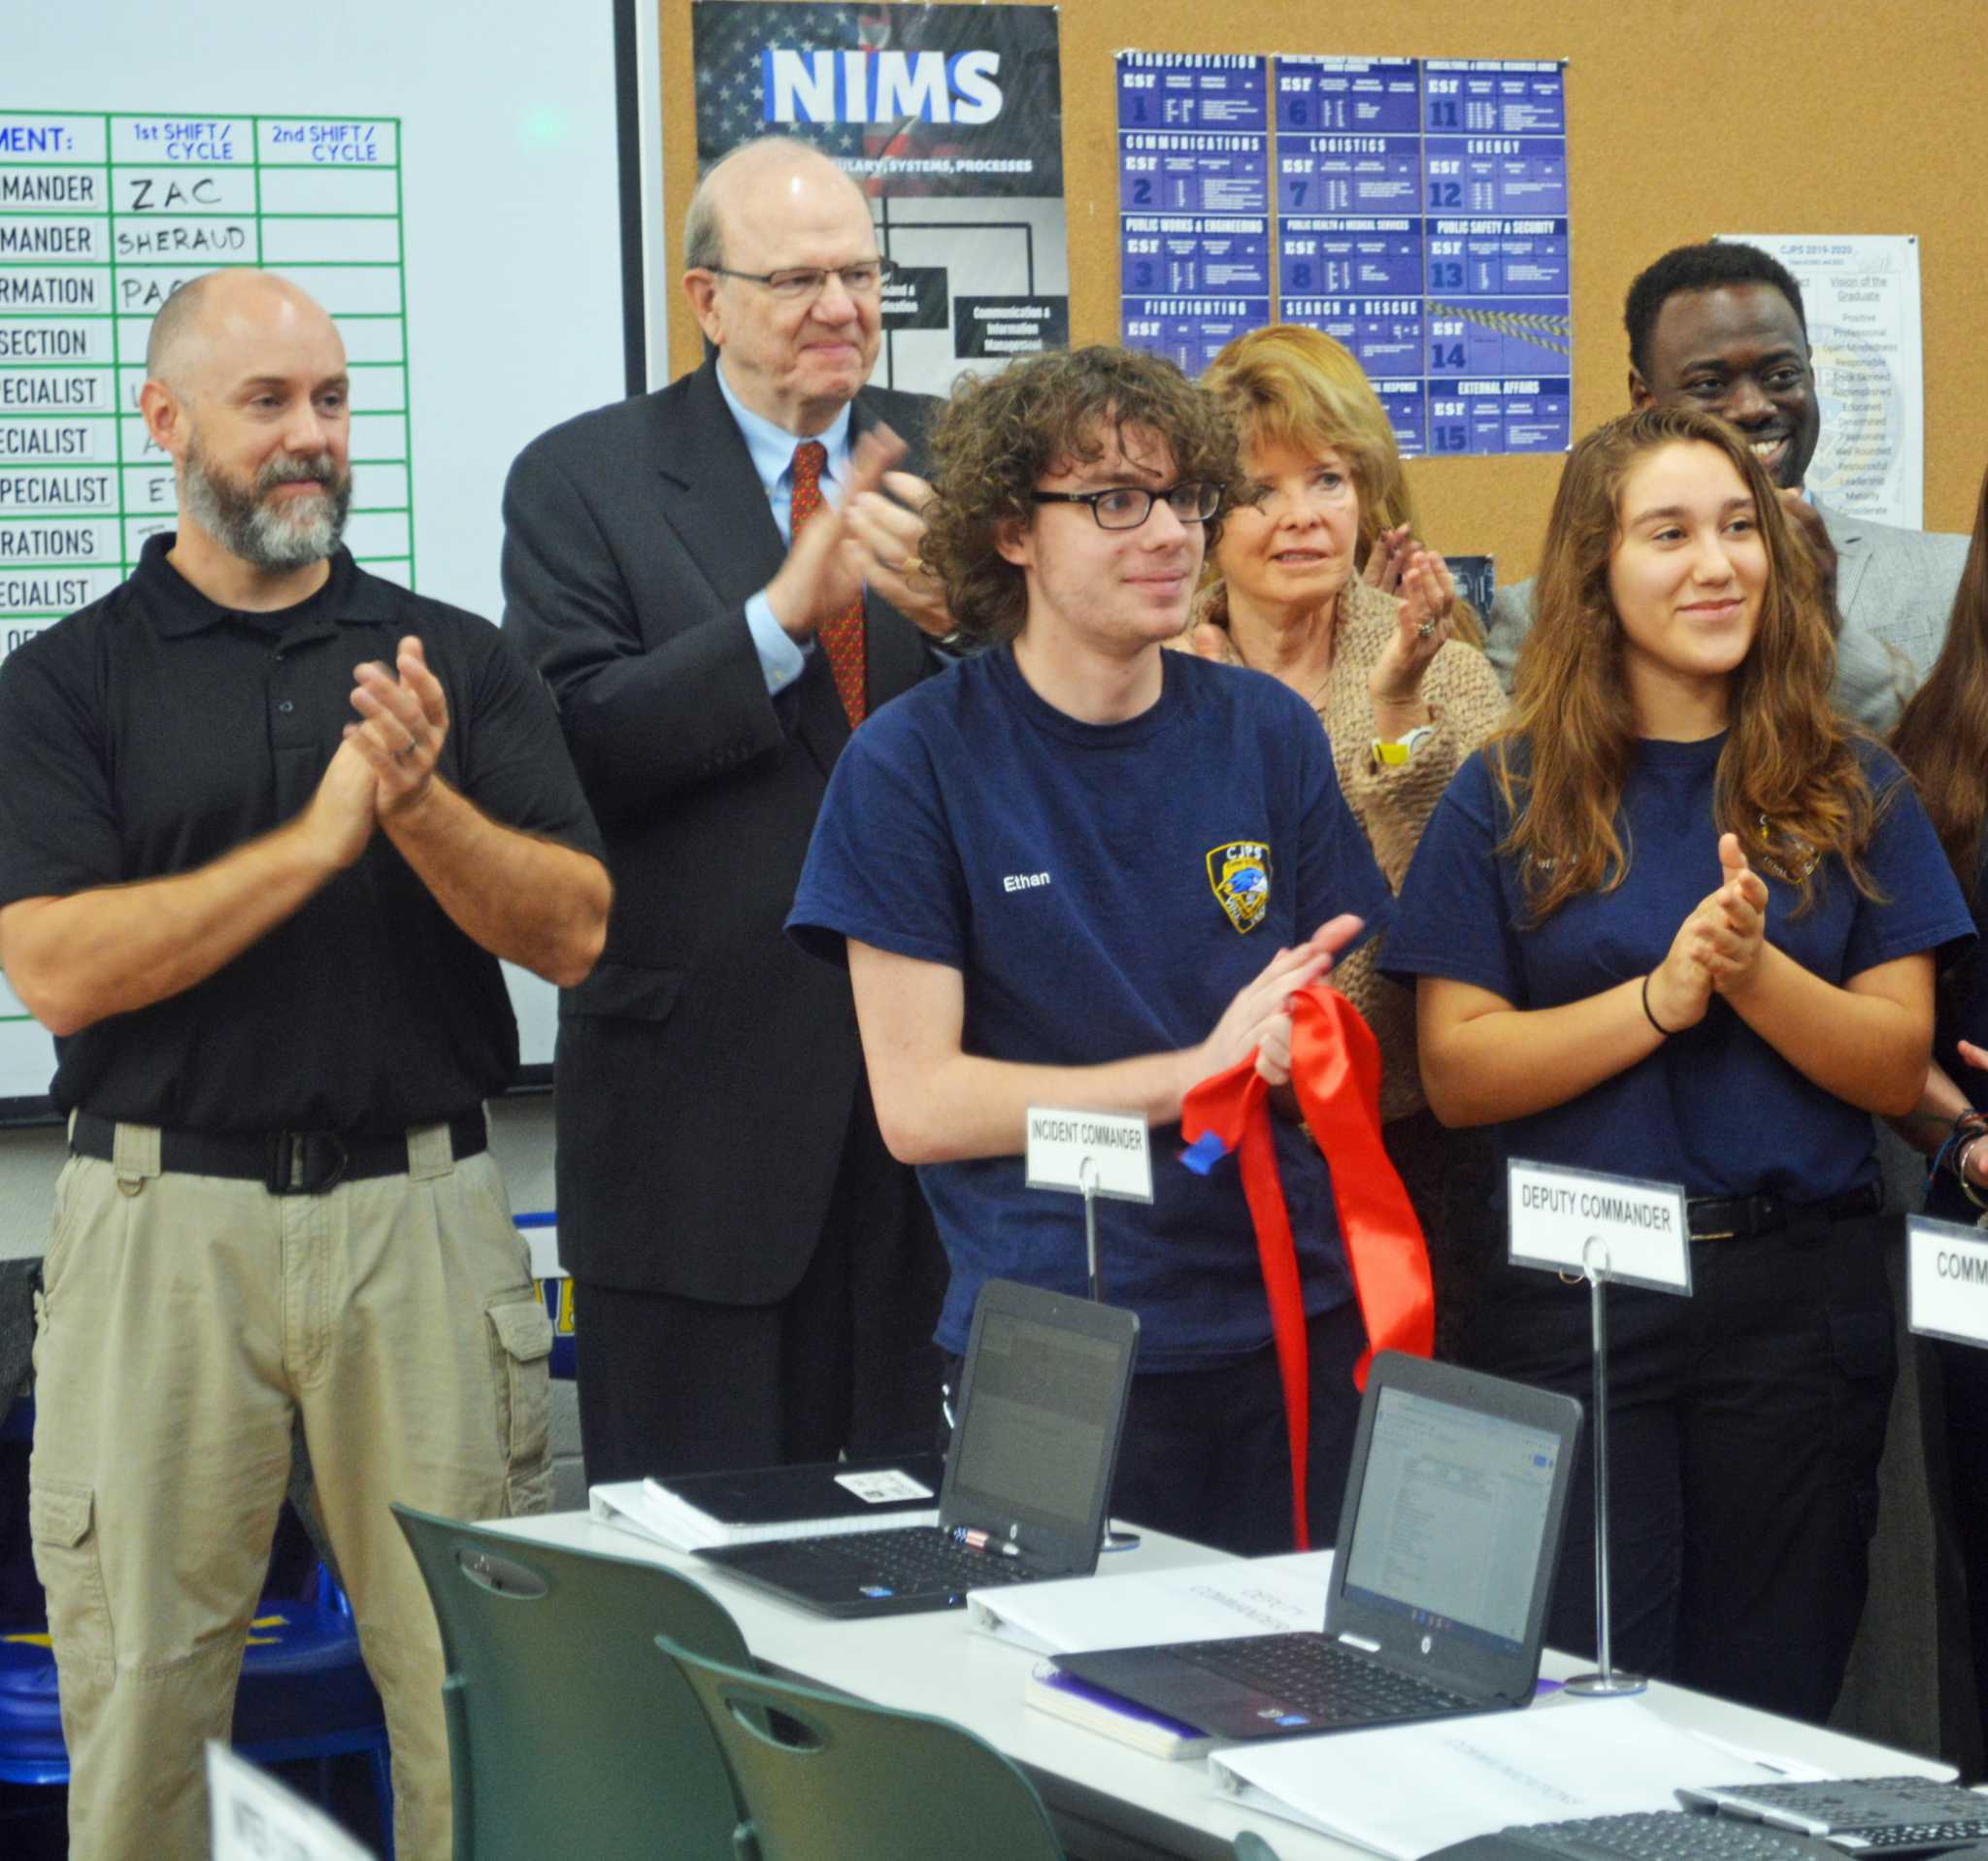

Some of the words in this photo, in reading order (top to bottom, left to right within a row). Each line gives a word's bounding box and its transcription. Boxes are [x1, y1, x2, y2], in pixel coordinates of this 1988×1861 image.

[1126, 53, 1256, 69] TRANSPORTATION
[763, 49, 1004, 124] NIMS
[1123, 74, 1155, 88] ESF
[1280, 77, 1312, 91] ESF
[1428, 80, 1459, 93] ESF
[1134, 96, 1146, 122] 1
[1290, 100, 1308, 125] 6
[1431, 101, 1458, 126] 11
[134, 123, 158, 141] 1st
[163, 123, 231, 141] SHIFT/
[272, 125, 305, 144] 2nd
[310, 125, 375, 144] SHIFT/
[166, 143, 233, 160] CYCLE
[1126, 135, 1259, 150] COMMUNICATIONS
[1310, 138, 1386, 152] LOGISTICS
[1468, 140, 1520, 153] ENERGY
[312, 145, 378, 162] CYCLE
[839, 159, 887, 173] ULARY,
[956, 158, 1032, 172] PROCESSES
[1125, 156, 1157, 171] ESF
[1282, 159, 1313, 173] ESF
[1430, 160, 1460, 174] ESF
[2, 176, 94, 202] MANDER
[130, 178, 221, 212] ZAC
[1133, 179, 1151, 205] 2
[1290, 181, 1308, 207] 7
[1429, 183, 1462, 208] 12
[0, 227, 91, 252] MANDER
[1127, 239, 1159, 253] ESF
[1284, 241, 1316, 254] ESF
[1432, 241, 1462, 255] ESF
[1135, 261, 1153, 287] 3
[1293, 263, 1310, 288] 8
[1432, 262, 1463, 288] 13
[1144, 301, 1246, 316] FIREFIGHTING
[1286, 301, 1341, 316] SEARCH
[1365, 301, 1417, 316] RESCUE
[1128, 322, 1160, 336] ESF
[1433, 322, 1464, 336] ESF
[0, 329, 86, 355] SECTION
[1432, 344, 1466, 369] 14
[3, 378, 96, 404] ECIALIST
[1435, 403, 1466, 416] ESF
[1435, 425, 1467, 451] 15
[1, 529, 94, 555] RATIONS
[1226, 845, 1262, 860] CJPS
[1004, 872, 1051, 892] Ethan
[1033, 1119, 1078, 1143] INCIDENT
[1081, 1123, 1143, 1150] COMMANDER
[1522, 1183, 1577, 1213] DEPUTY
[1580, 1193, 1672, 1233] COMMANDER
[1937, 1250, 1988, 1286] COMM
